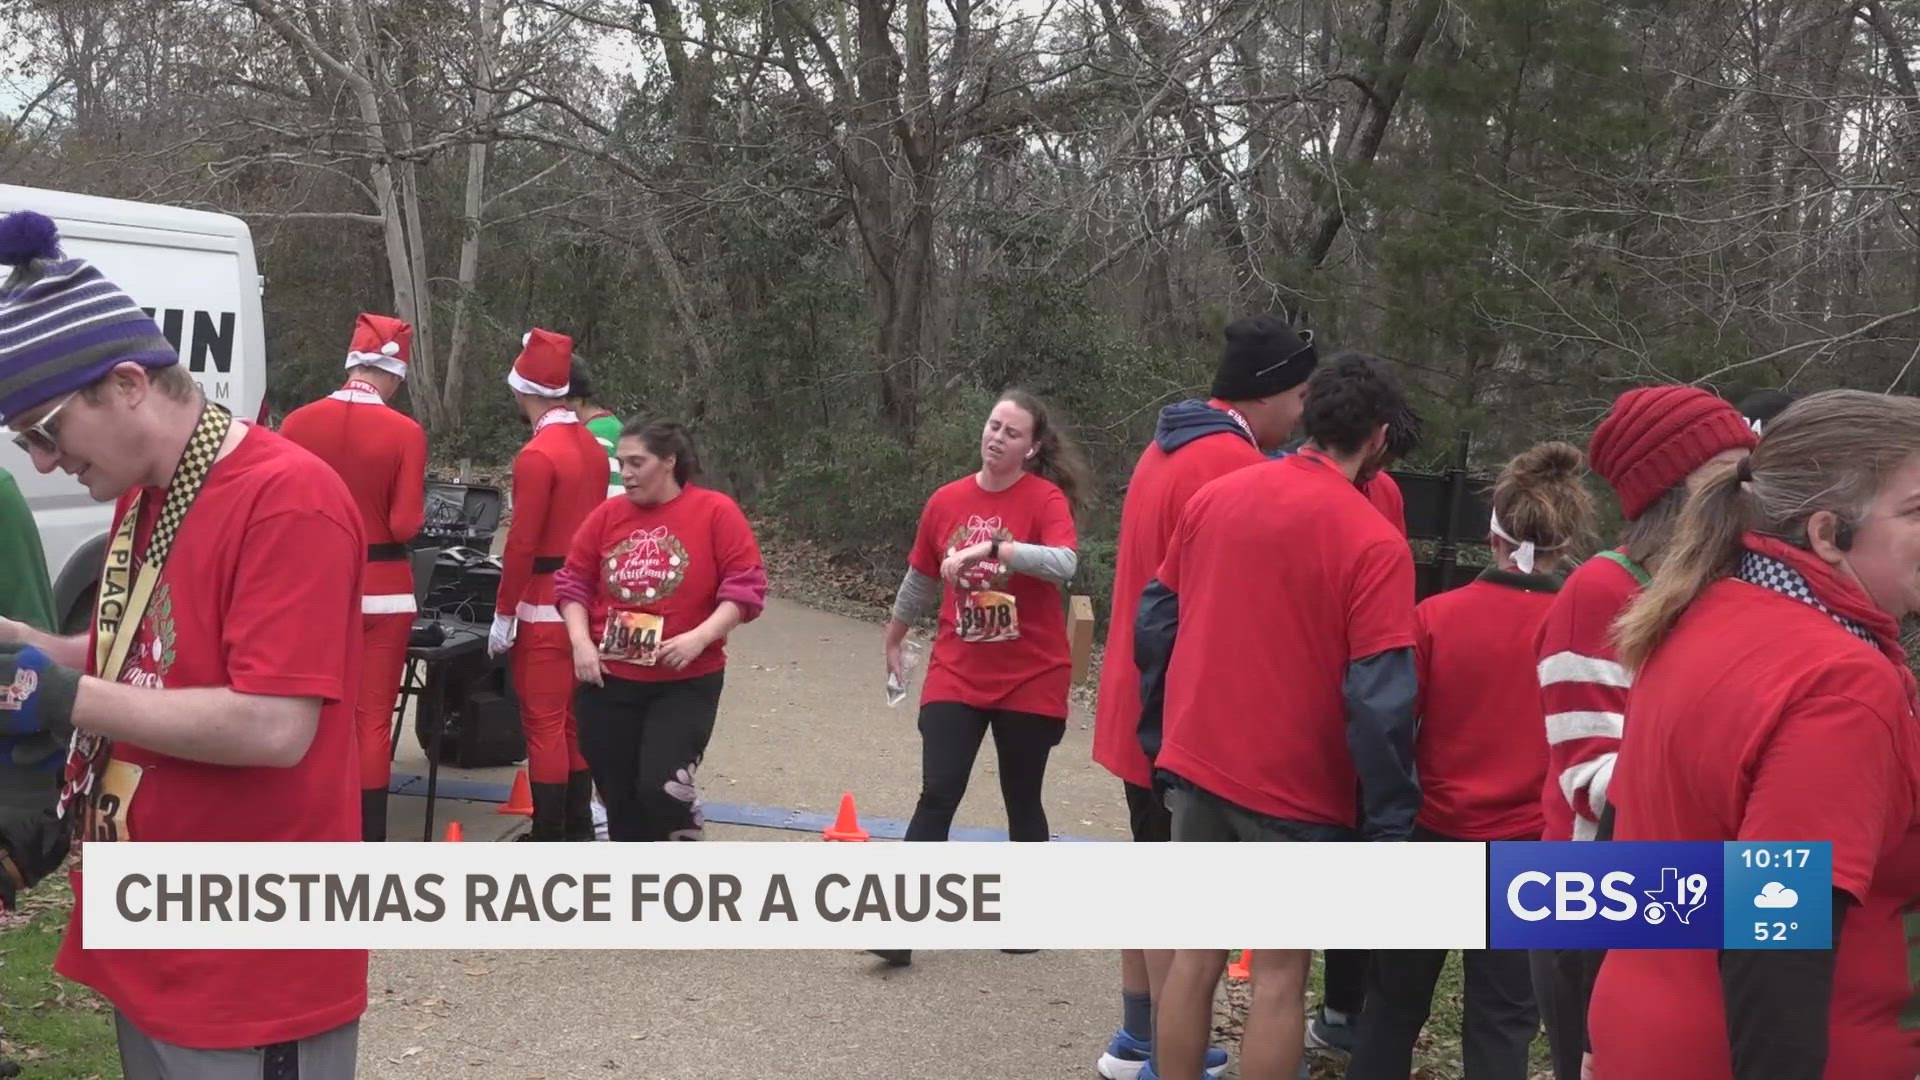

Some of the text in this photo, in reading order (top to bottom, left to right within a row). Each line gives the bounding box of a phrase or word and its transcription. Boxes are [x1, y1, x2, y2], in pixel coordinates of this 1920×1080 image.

[141, 308, 236, 373] IN
[100, 549, 129, 634] PLACE
[603, 624, 657, 651] 3944
[961, 603, 1012, 629] 3978
